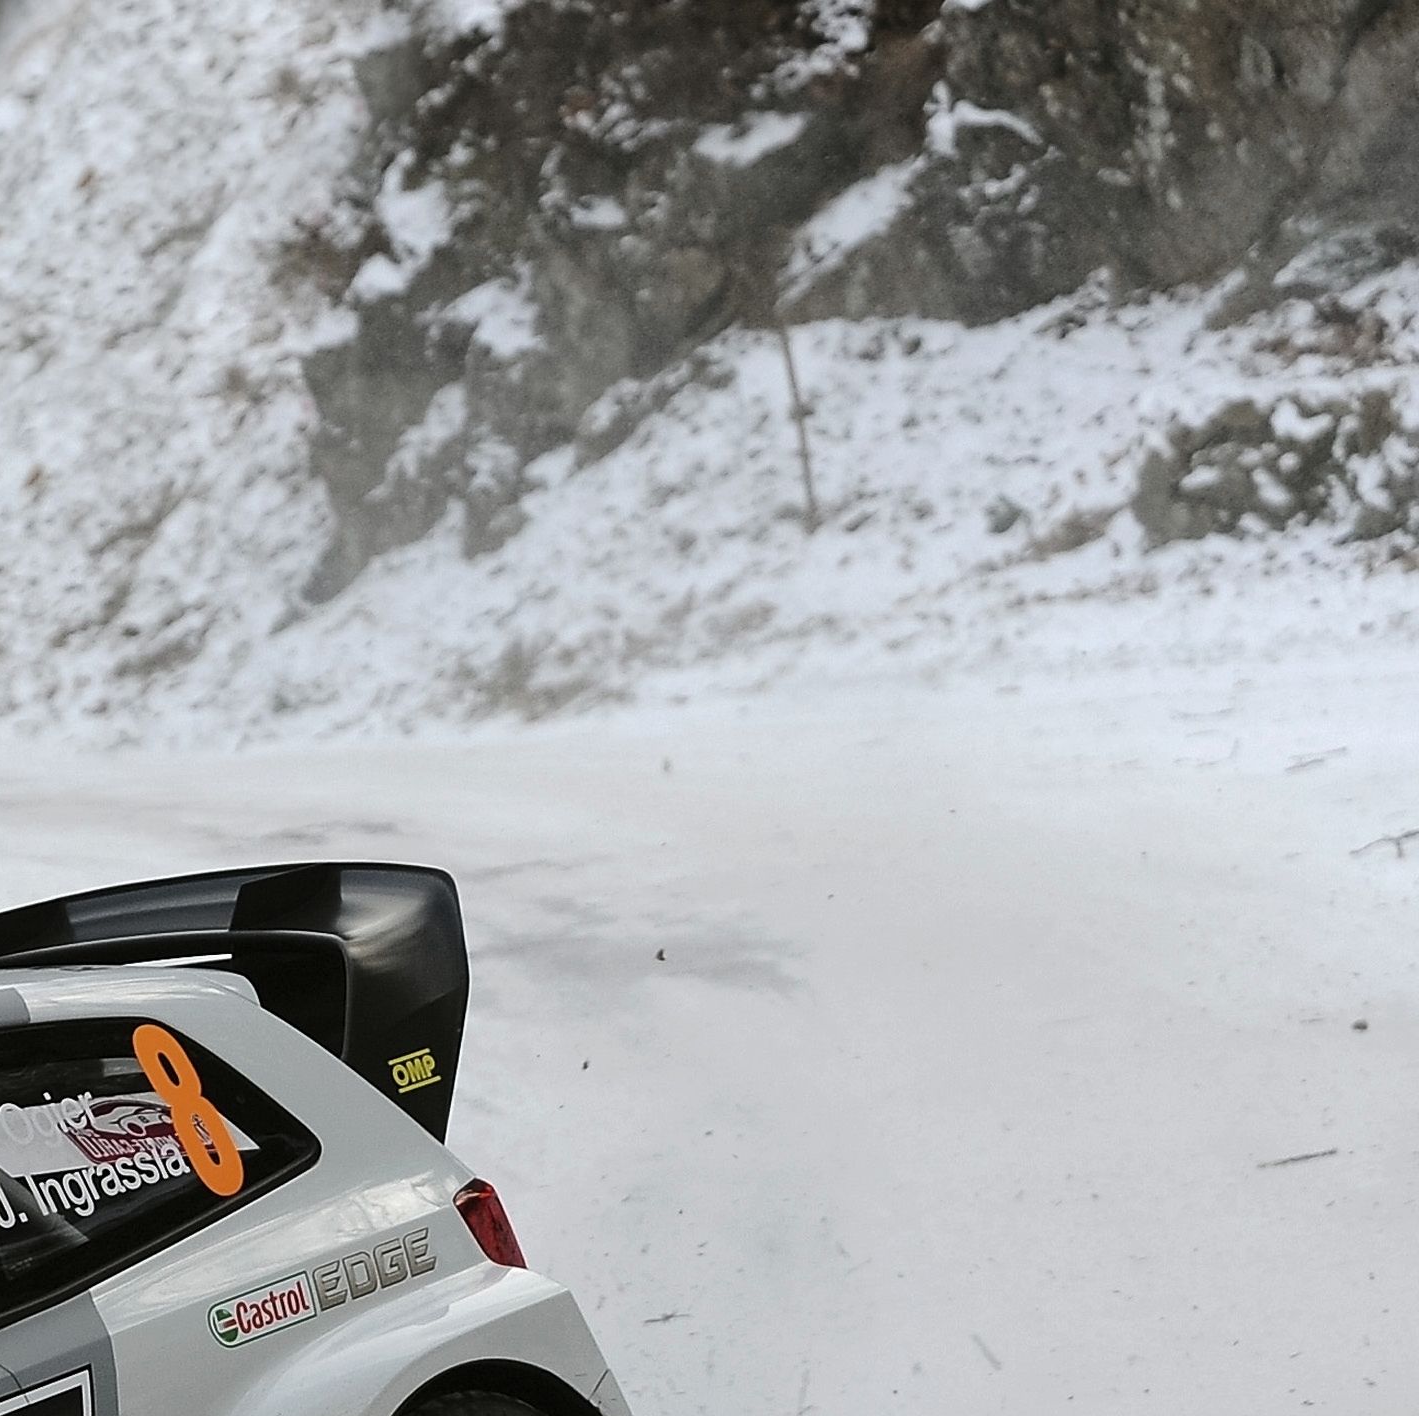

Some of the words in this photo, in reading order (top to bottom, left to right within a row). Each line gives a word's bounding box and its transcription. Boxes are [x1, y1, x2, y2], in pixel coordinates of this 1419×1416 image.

[392, 1053, 437, 1087] OMP
[0, 1091, 93, 1149] Ogier
[133, 1024, 244, 1196] 8
[27, 1142, 191, 1217] Ingrassia
[235, 1281, 310, 1334] Castrol
[313, 1226, 437, 1312] EDGE
